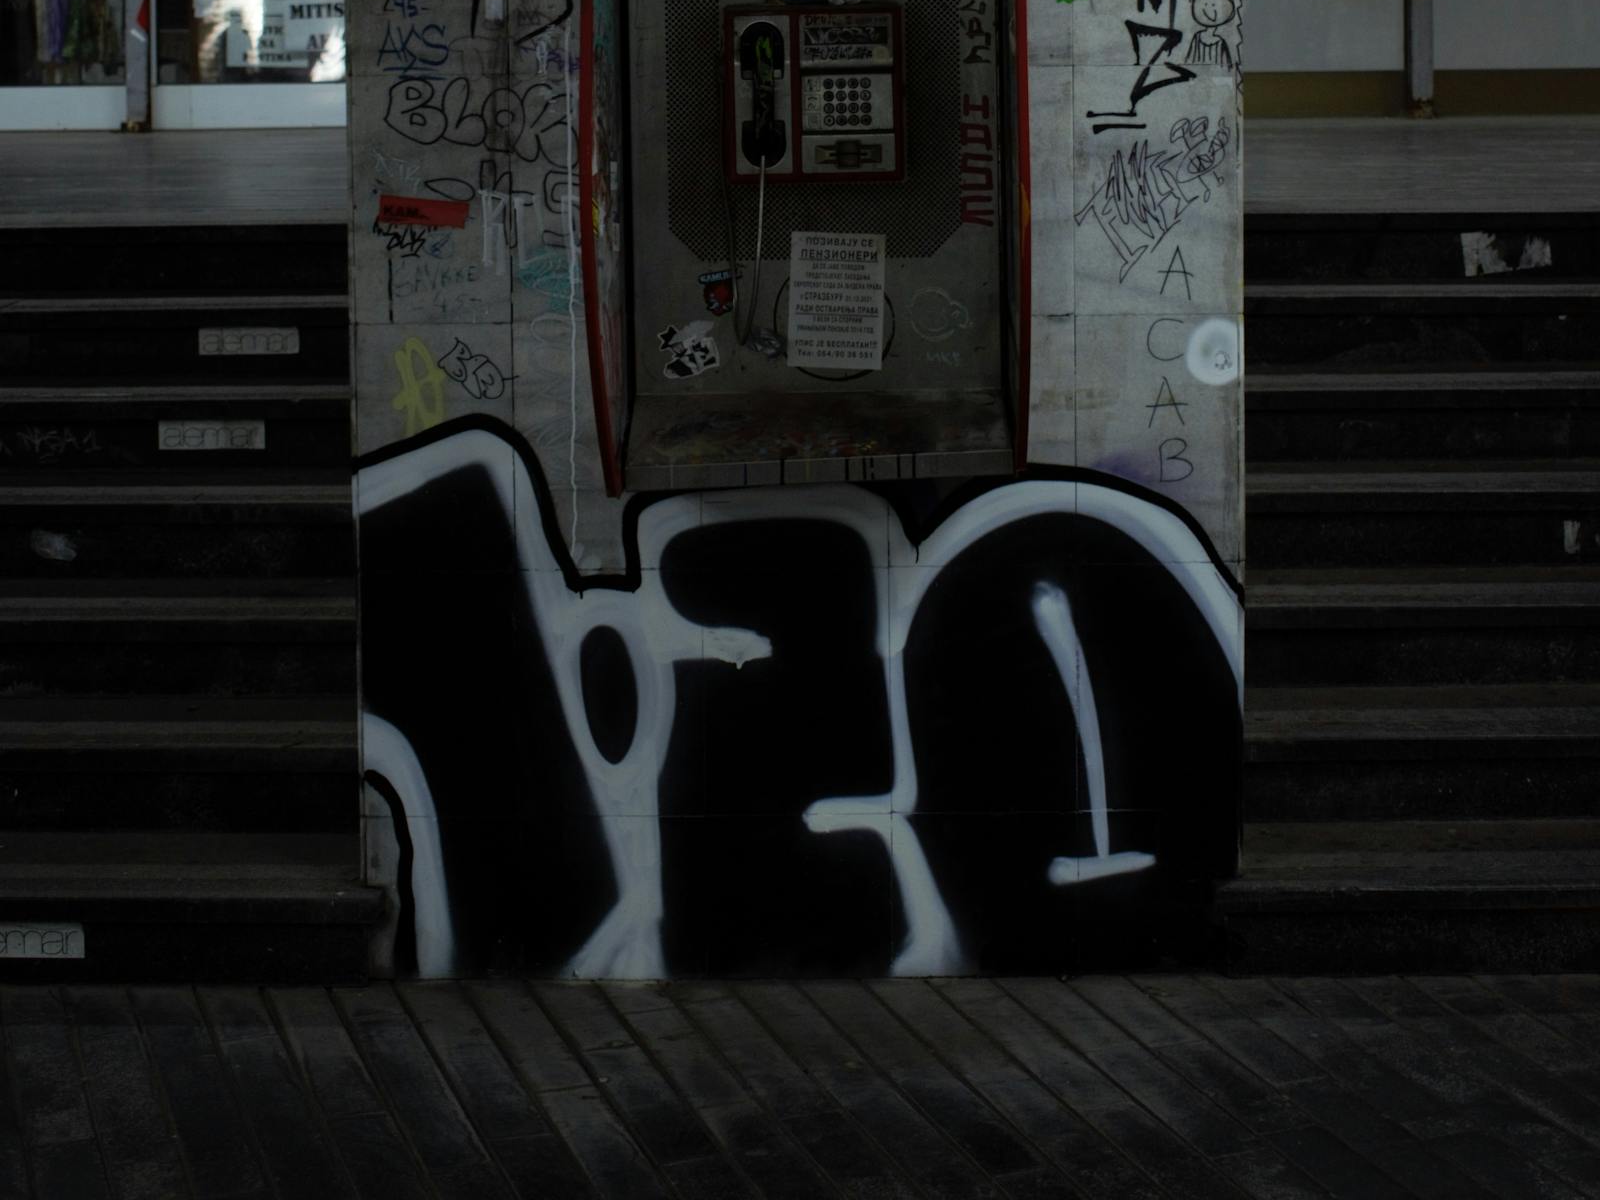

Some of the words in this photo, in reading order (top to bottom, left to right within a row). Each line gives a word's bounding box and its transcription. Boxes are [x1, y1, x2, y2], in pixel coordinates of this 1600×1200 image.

[806, 237, 857, 247] ПОЗИВАЈУ
[860, 239, 874, 248] СЕ
[800, 248, 878, 261] ПЕНЗИОНЕРИ
